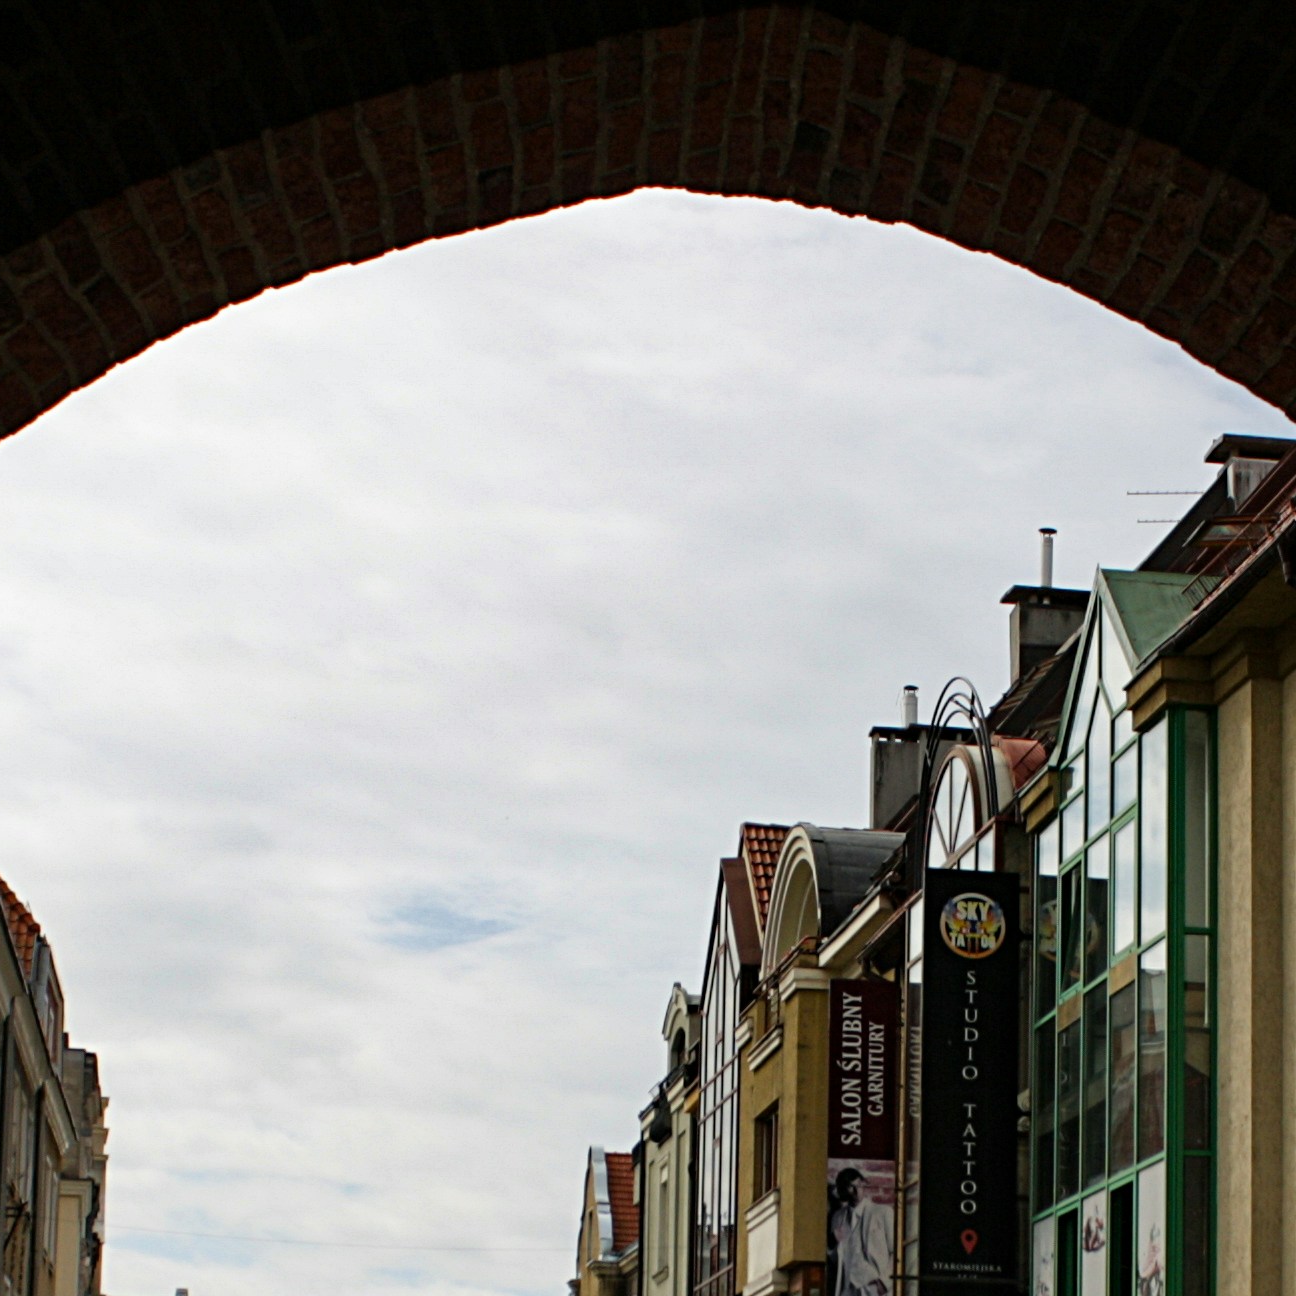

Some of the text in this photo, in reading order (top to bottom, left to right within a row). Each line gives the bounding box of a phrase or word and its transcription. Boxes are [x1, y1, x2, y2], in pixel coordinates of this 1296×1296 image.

[956, 900, 990, 921] SKY
[836, 992, 862, 1146] SALON ŚLUBNY
[867, 1021, 885, 1116] GARNITURY
[960, 970, 979, 1215] STUDIO TATTOO
